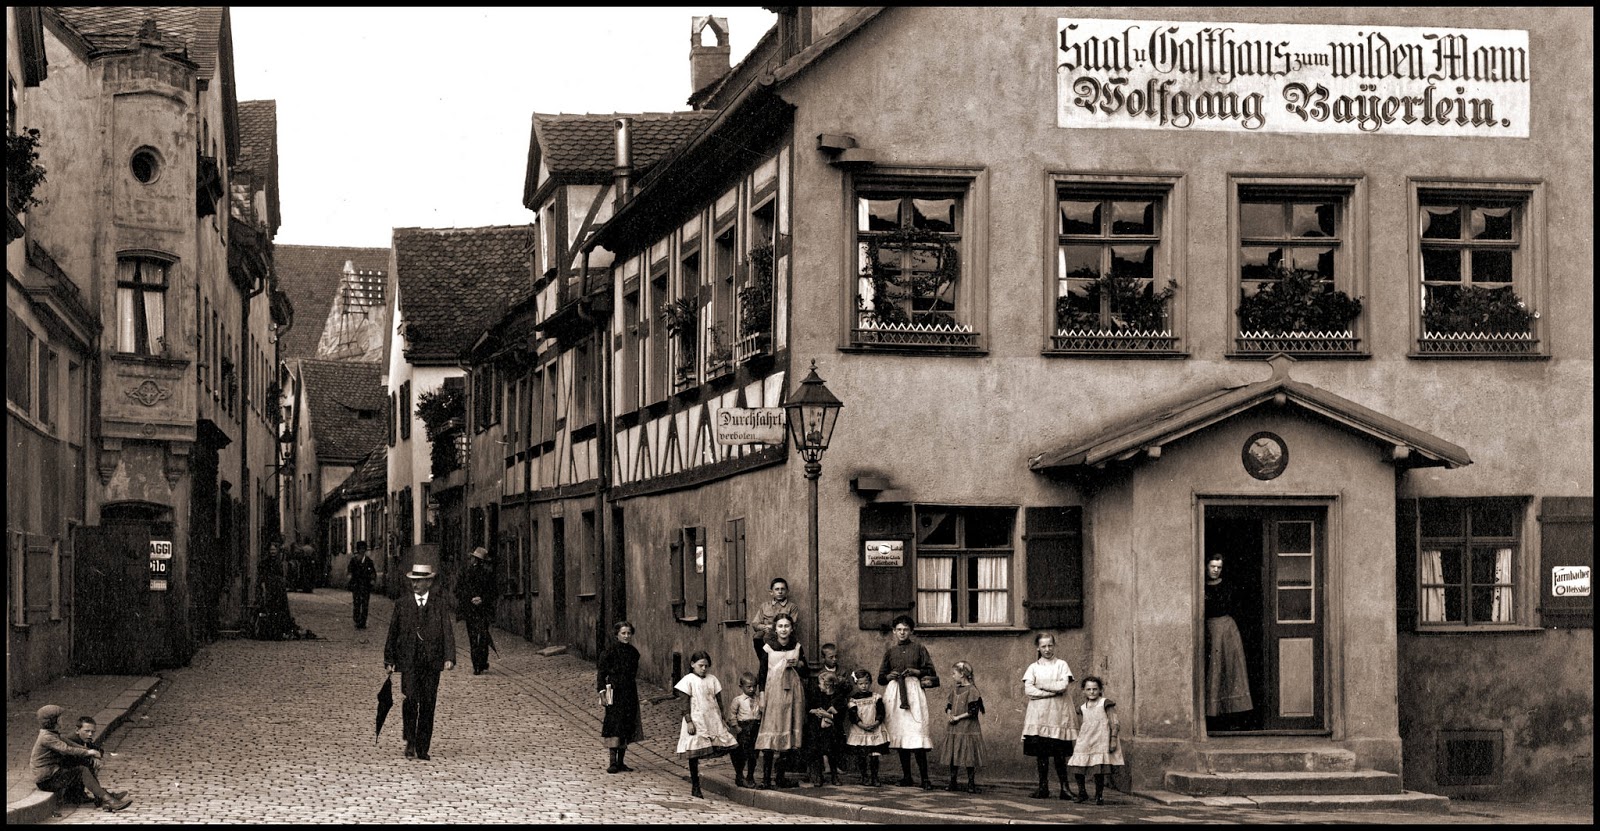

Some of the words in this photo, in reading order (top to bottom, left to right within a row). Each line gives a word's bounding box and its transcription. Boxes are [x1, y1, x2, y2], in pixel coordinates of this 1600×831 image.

[1057, 23, 1140, 74] Saal
[1149, 26, 1292, 84] Gasthaus
[1292, 52, 1329, 71] zum
[1328, 31, 1426, 80] wilden
[1423, 33, 1529, 84] Mann
[1073, 76, 1266, 130] Wolfgang
